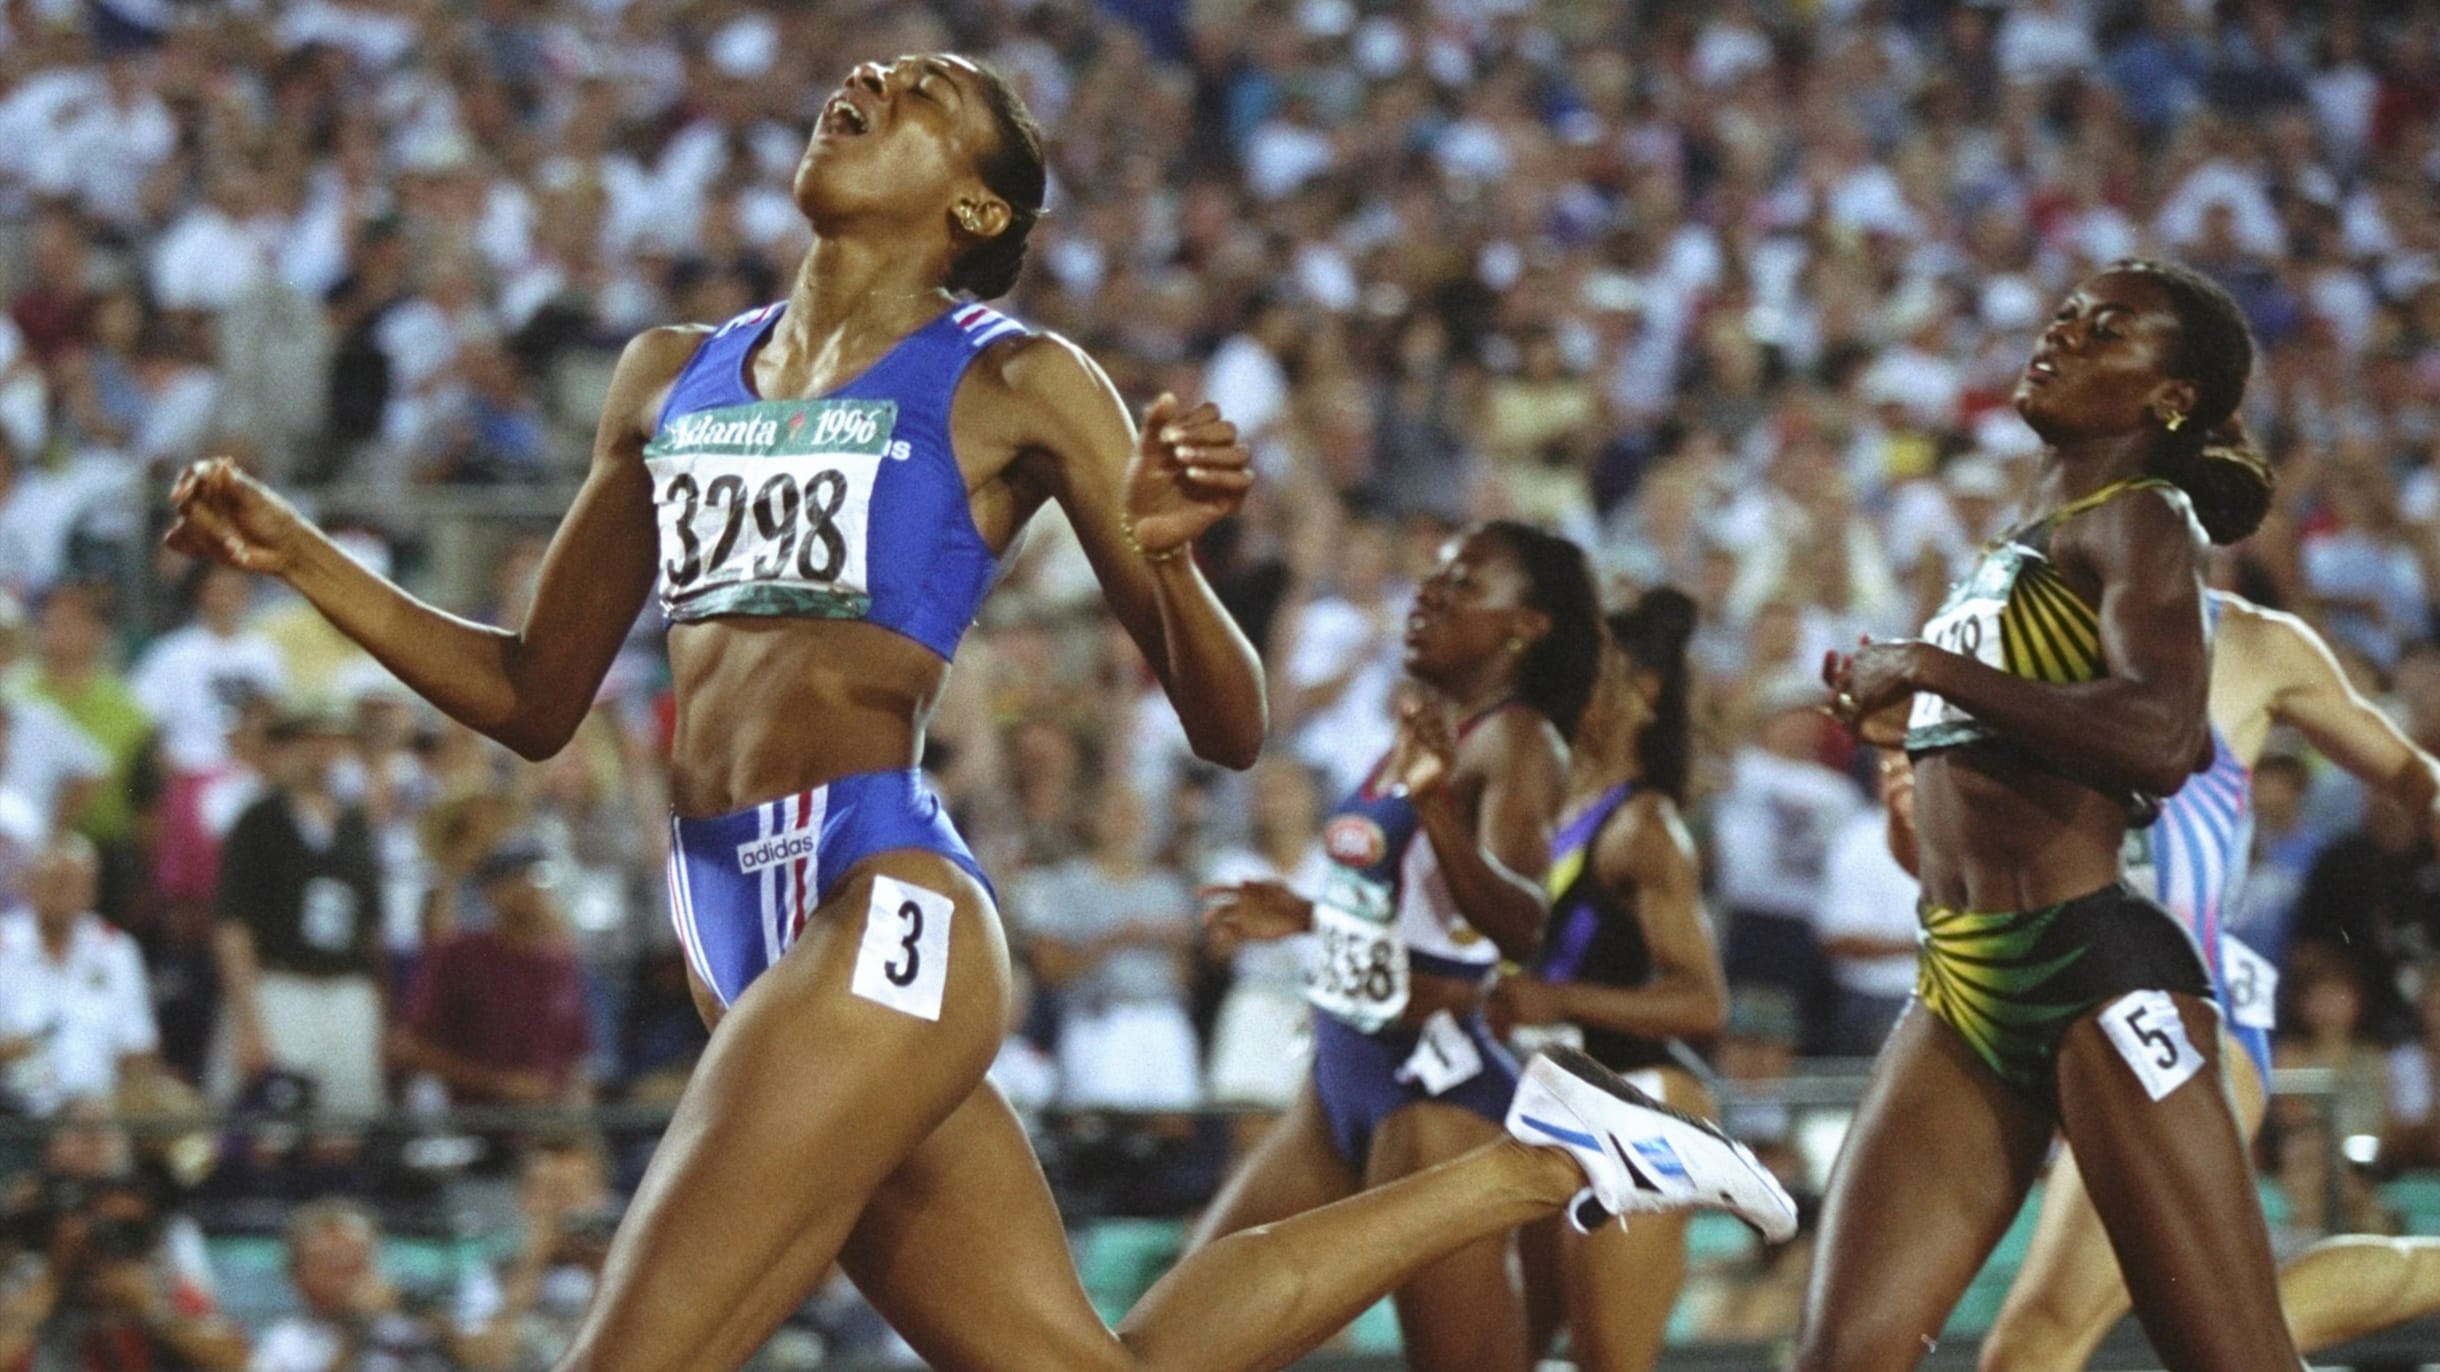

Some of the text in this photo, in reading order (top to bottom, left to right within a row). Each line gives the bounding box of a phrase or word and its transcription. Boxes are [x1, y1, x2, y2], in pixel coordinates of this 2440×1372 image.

[665, 408, 883, 449] Atlanta 1996
[666, 469, 848, 587] 3298
[741, 835, 814, 869] adidas
[884, 900, 924, 986] 3
[2126, 1006, 2180, 1070] 5
